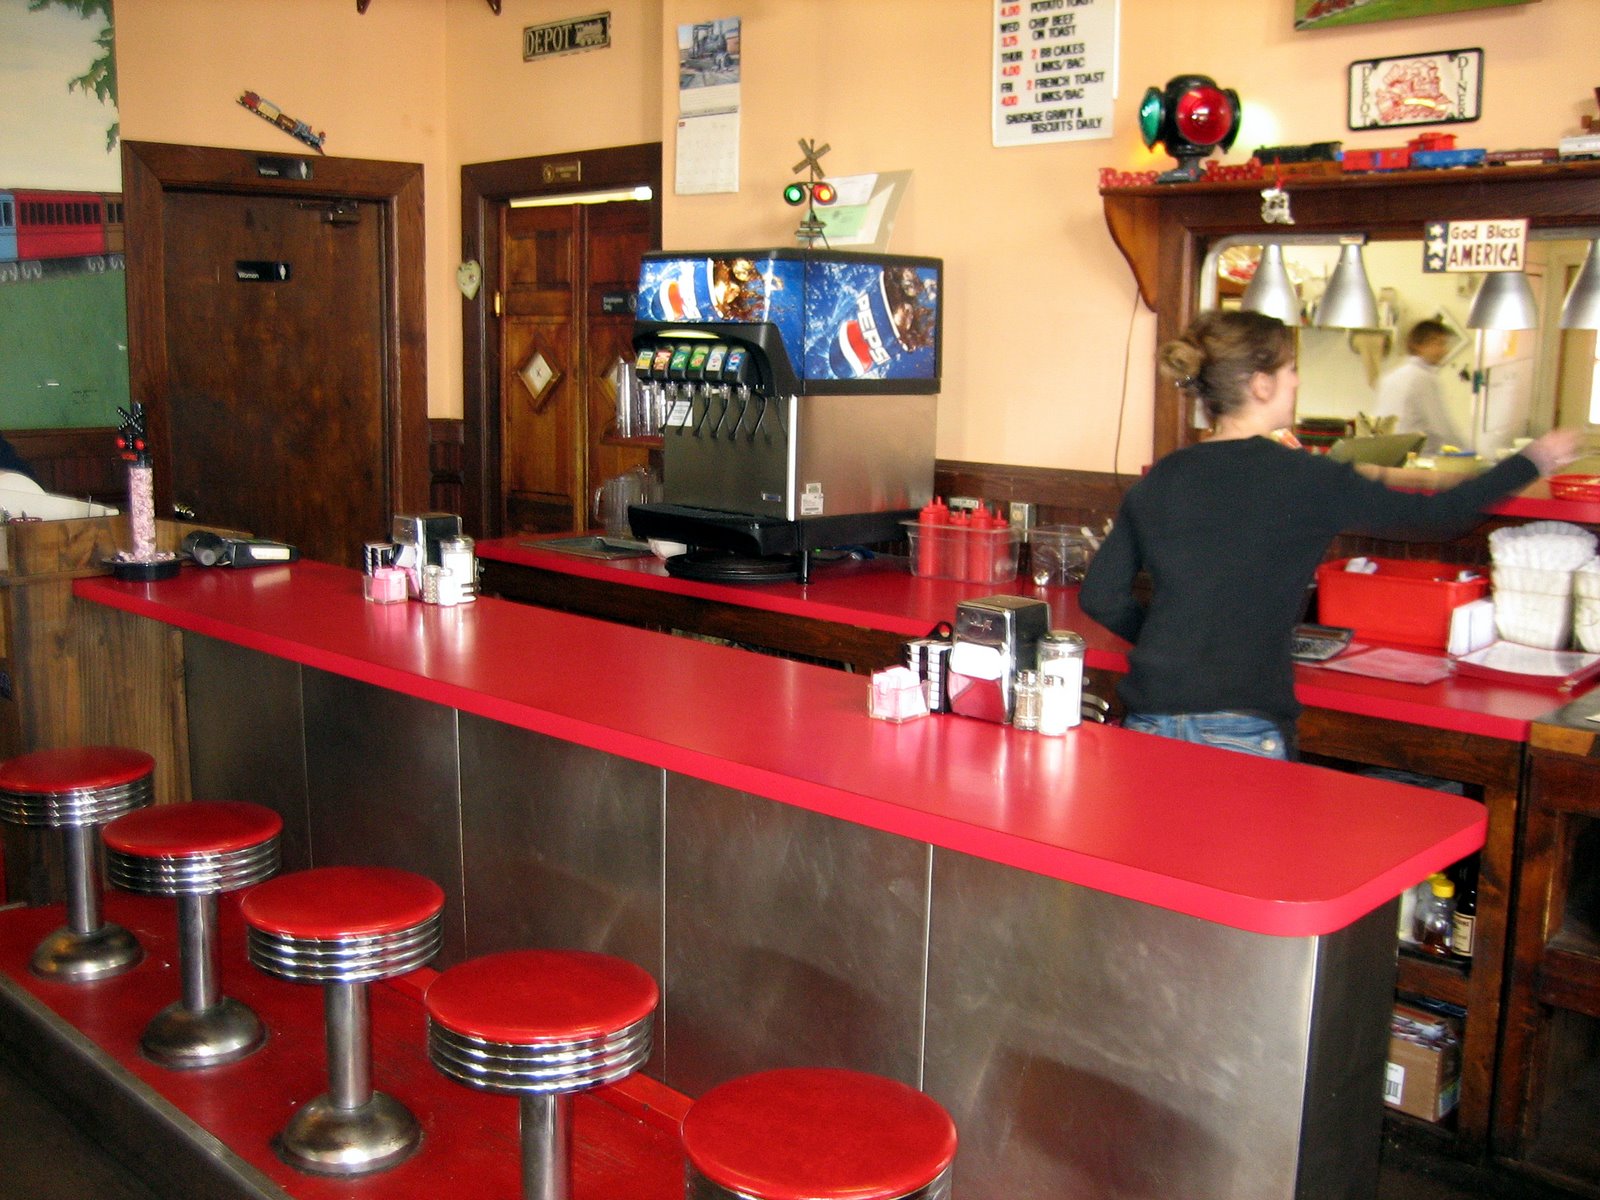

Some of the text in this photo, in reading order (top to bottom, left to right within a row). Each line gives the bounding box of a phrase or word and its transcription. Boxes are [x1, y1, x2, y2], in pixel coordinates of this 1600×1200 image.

[1049, 25, 1076, 39] TOAST
[526, 25, 571, 56] DEPOT
[1053, 43, 1085, 57] CAKES
[1075, 71, 1105, 85] TOAST
[1457, 55, 1469, 120] DINER
[1360, 66, 1372, 126] DEPOT
[1006, 111, 1044, 125] SAUSAGE
[1031, 117, 1102, 134] BISCUITS DAILY
[1450, 224, 1521, 240] God Bless
[1448, 242, 1520, 267] AMERICA
[237, 271, 260, 280] Women
